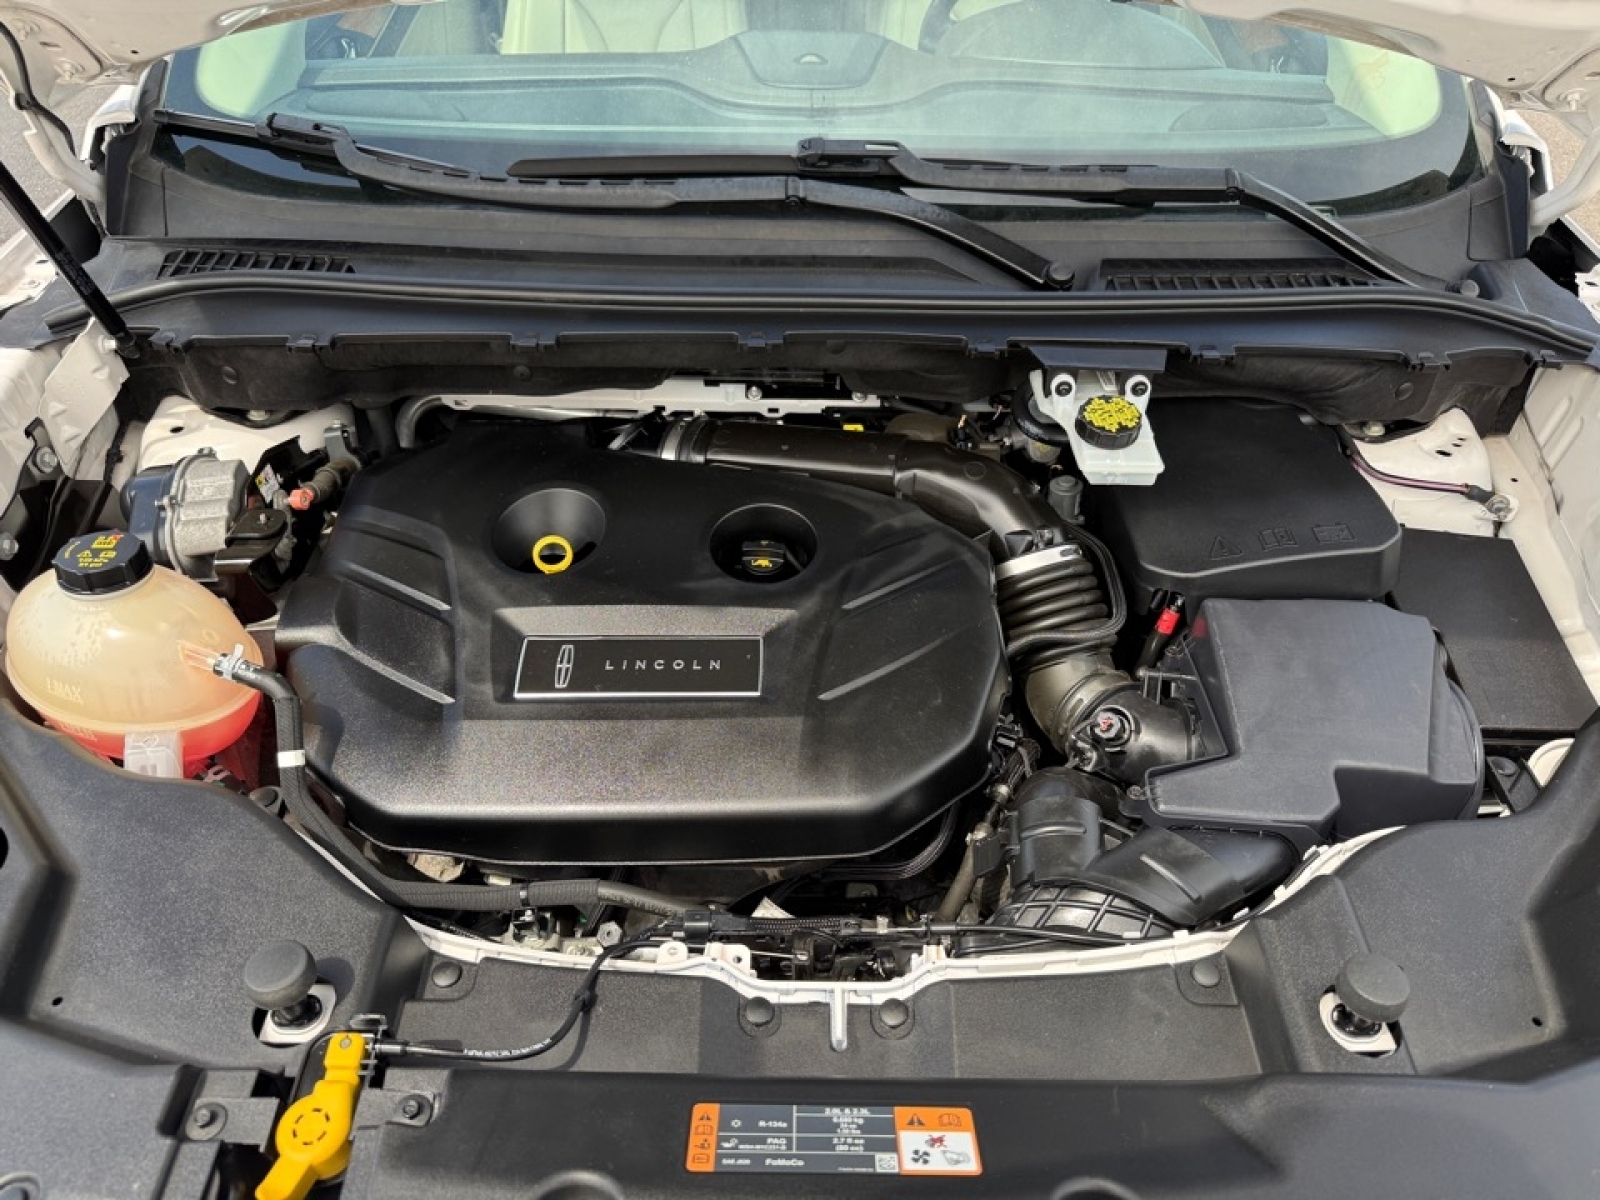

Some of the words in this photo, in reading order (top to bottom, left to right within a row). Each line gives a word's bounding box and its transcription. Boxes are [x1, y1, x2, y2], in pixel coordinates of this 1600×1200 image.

[604, 659, 721, 671] LINCOLN
[758, 1119, 788, 1128] R-134a
[766, 1137, 787, 1145] PAG
[765, 1157, 805, 1167] FoMoCo
